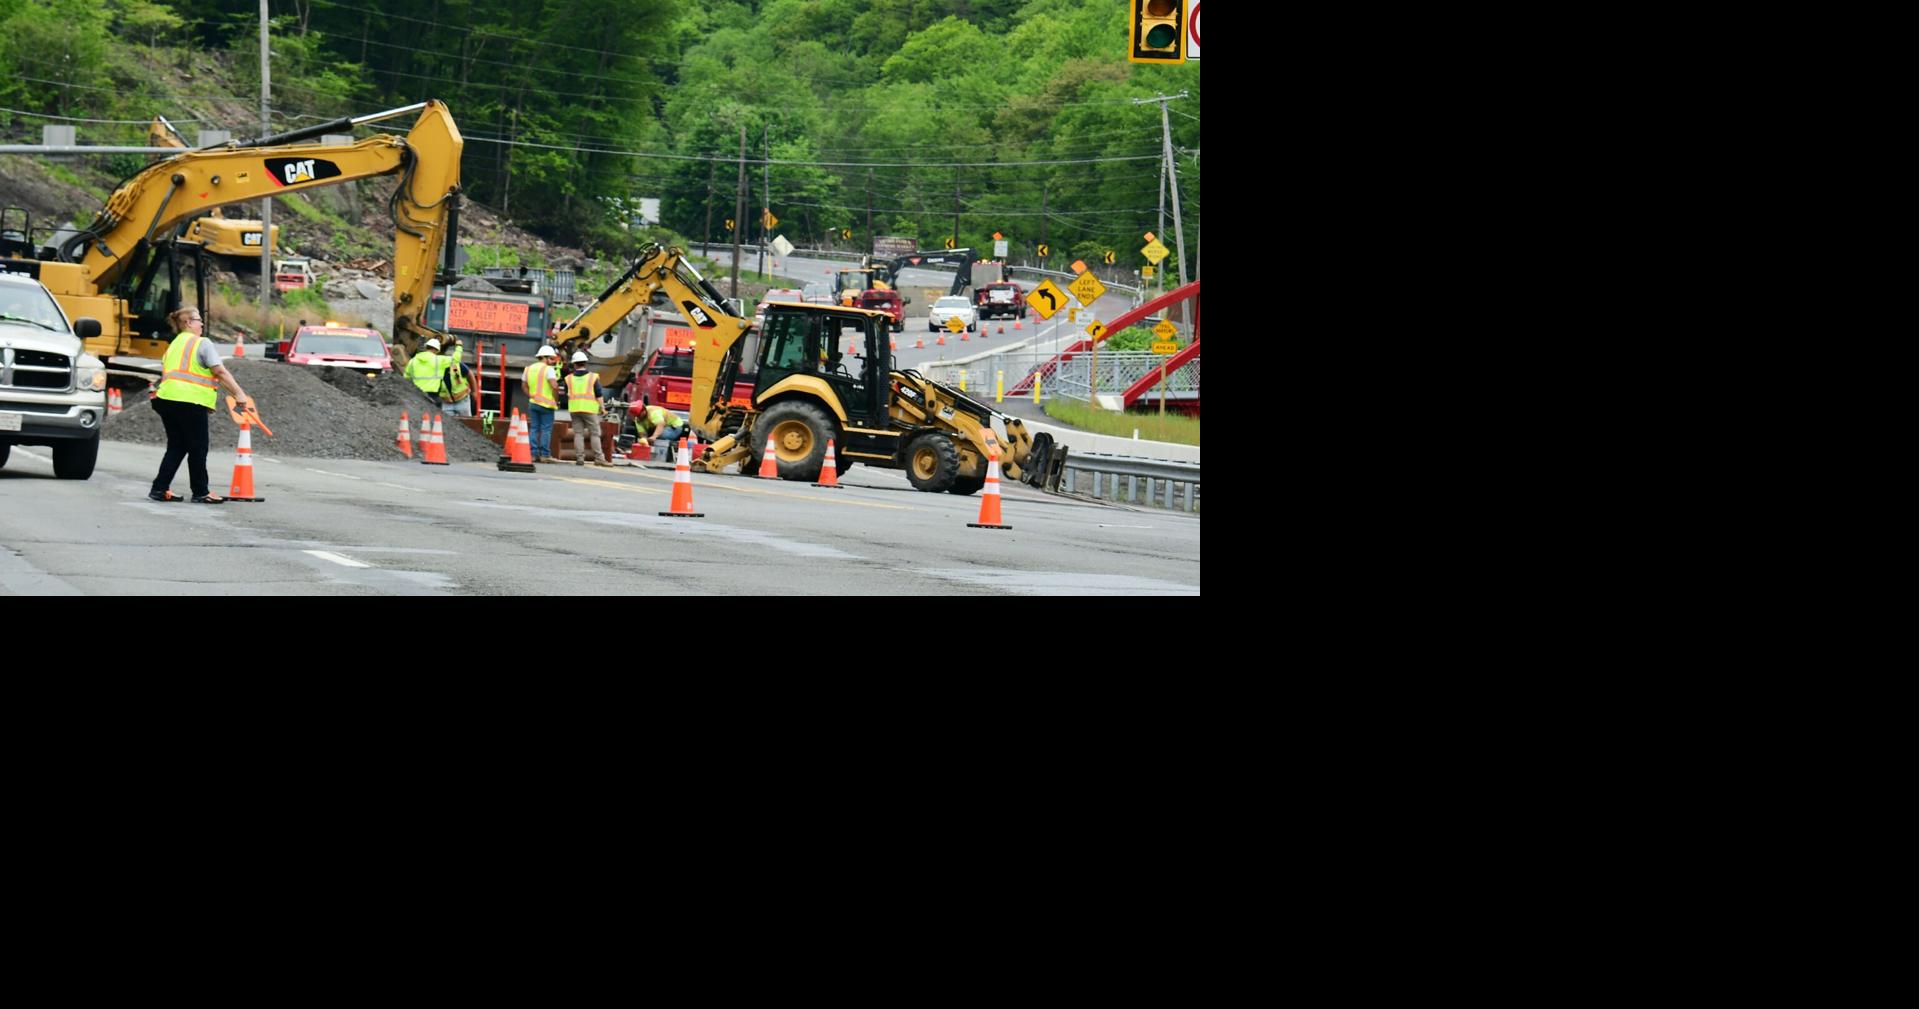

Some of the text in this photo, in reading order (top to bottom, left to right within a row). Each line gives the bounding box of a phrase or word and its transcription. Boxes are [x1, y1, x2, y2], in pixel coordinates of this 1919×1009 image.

[284, 160, 315, 184] CAT
[244, 233, 262, 245] CAT
[449, 299, 528, 313] CONSTRUCTION VEHICLE
[450, 308, 522, 321] KEEP ALERT FOR
[690, 306, 708, 325] CAT
